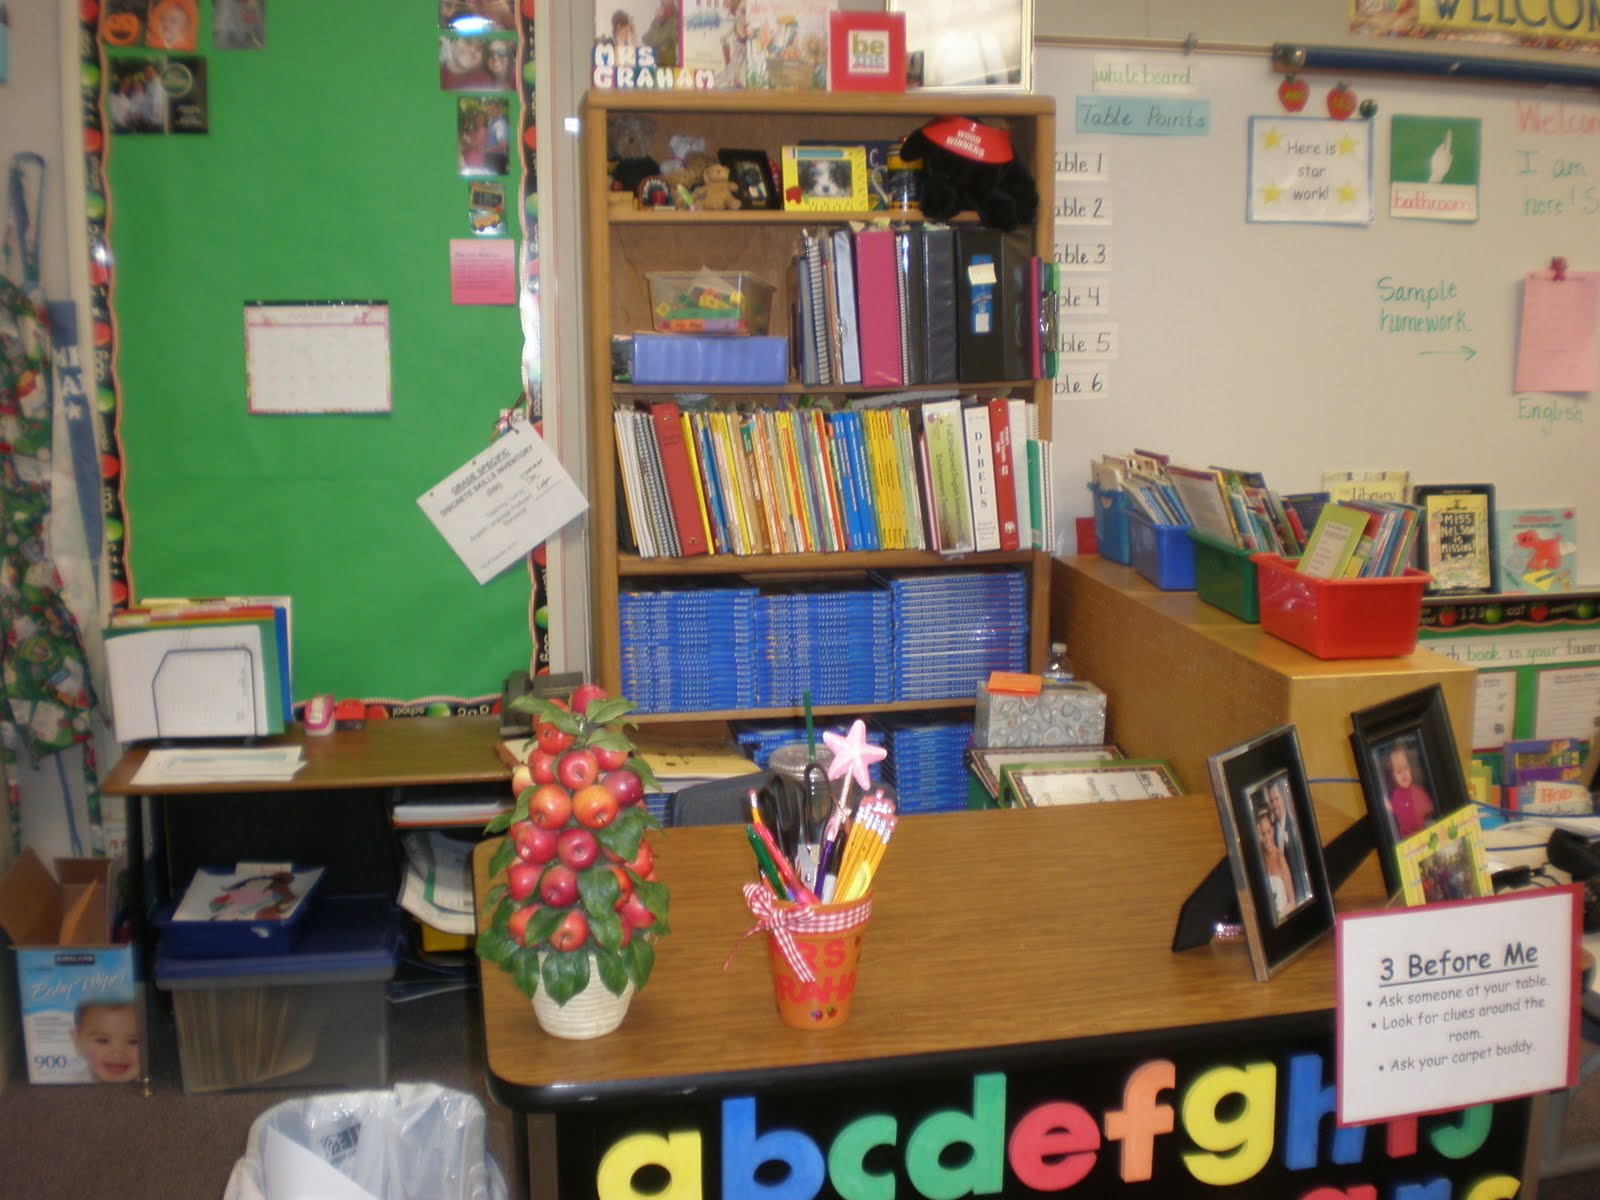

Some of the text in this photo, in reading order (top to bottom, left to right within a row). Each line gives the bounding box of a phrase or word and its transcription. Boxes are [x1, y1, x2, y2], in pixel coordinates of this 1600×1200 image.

[852, 31, 886, 55] be
[593, 66, 715, 89] GRAHAM
[1095, 63, 1194, 86] whiteboard
[1080, 103, 1208, 129] Table Points
[1287, 140, 1337, 156] Here is
[1054, 153, 1103, 174] able 1
[1297, 164, 1327, 178] star
[1552, 159, 1588, 179] am
[1293, 185, 1330, 201] work!
[1054, 198, 1105, 219] able 2
[1053, 244, 1107, 265] able 3
[1087, 286, 1101, 307] 4
[1377, 275, 1458, 311] Sample
[1060, 331, 1111, 353] ble 5
[1054, 373, 1104, 394] ble 6
[974, 431, 989, 509] DIBELS
[1443, 514, 1472, 524] MISS
[1440, 525, 1475, 537] NELSON
[1441, 543, 1474, 553] MISSING
[1467, 644, 1499, 661] book
[1509, 648, 1522, 659] is
[1527, 646, 1560, 664] your
[1380, 942, 1539, 982] 3 Before Me
[1378, 995, 1404, 1010] Ask
[1407, 988, 1463, 1005] someone
[1466, 985, 1480, 998] at
[1483, 981, 1512, 1002] your
[1382, 995, 1546, 1031] Look for clues around the
[1448, 1028, 1484, 1043] room.
[33, 1055, 68, 1070] 900
[1390, 1039, 1536, 1073] Ask your carpet buddy.
